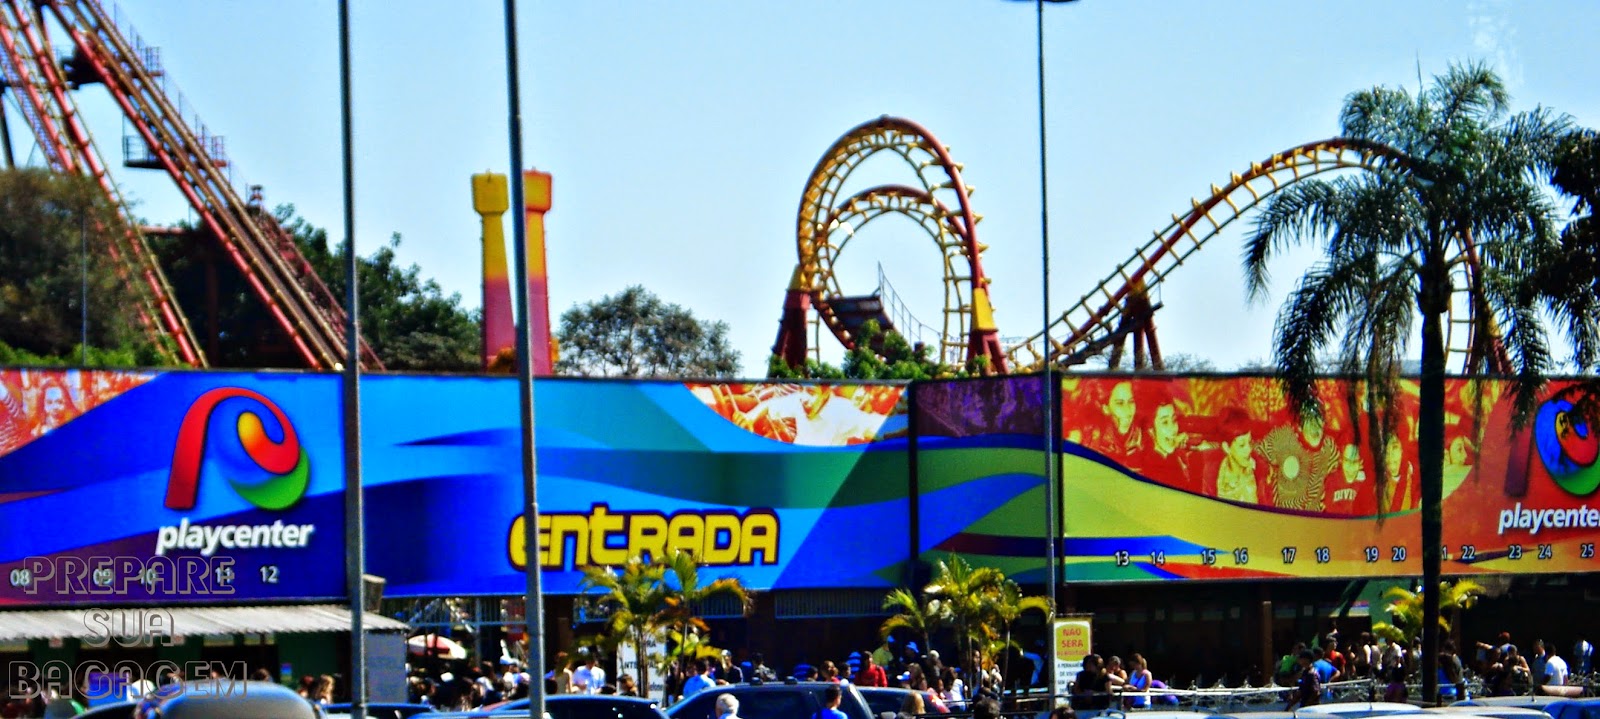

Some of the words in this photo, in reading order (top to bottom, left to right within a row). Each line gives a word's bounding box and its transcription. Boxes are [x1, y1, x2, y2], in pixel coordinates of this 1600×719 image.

[1497, 502, 1600, 535] playcente
[155, 517, 315, 556] playcenter
[1115, 551, 1130, 566] 13
[1151, 551, 1165, 565] 14
[1202, 549, 1216, 564] 15
[1234, 548, 1248, 563] 16
[1282, 547, 1296, 562] 17
[1316, 547, 1330, 562] 18
[1365, 547, 1379, 561] 19
[1392, 546, 1406, 561] 20
[1462, 545, 1475, 559] 22
[1508, 545, 1522, 559] 23
[1538, 545, 1552, 559] 24
[1581, 544, 1594, 558] 25
[10, 568, 31, 586] 08
[259, 565, 279, 584] 12
